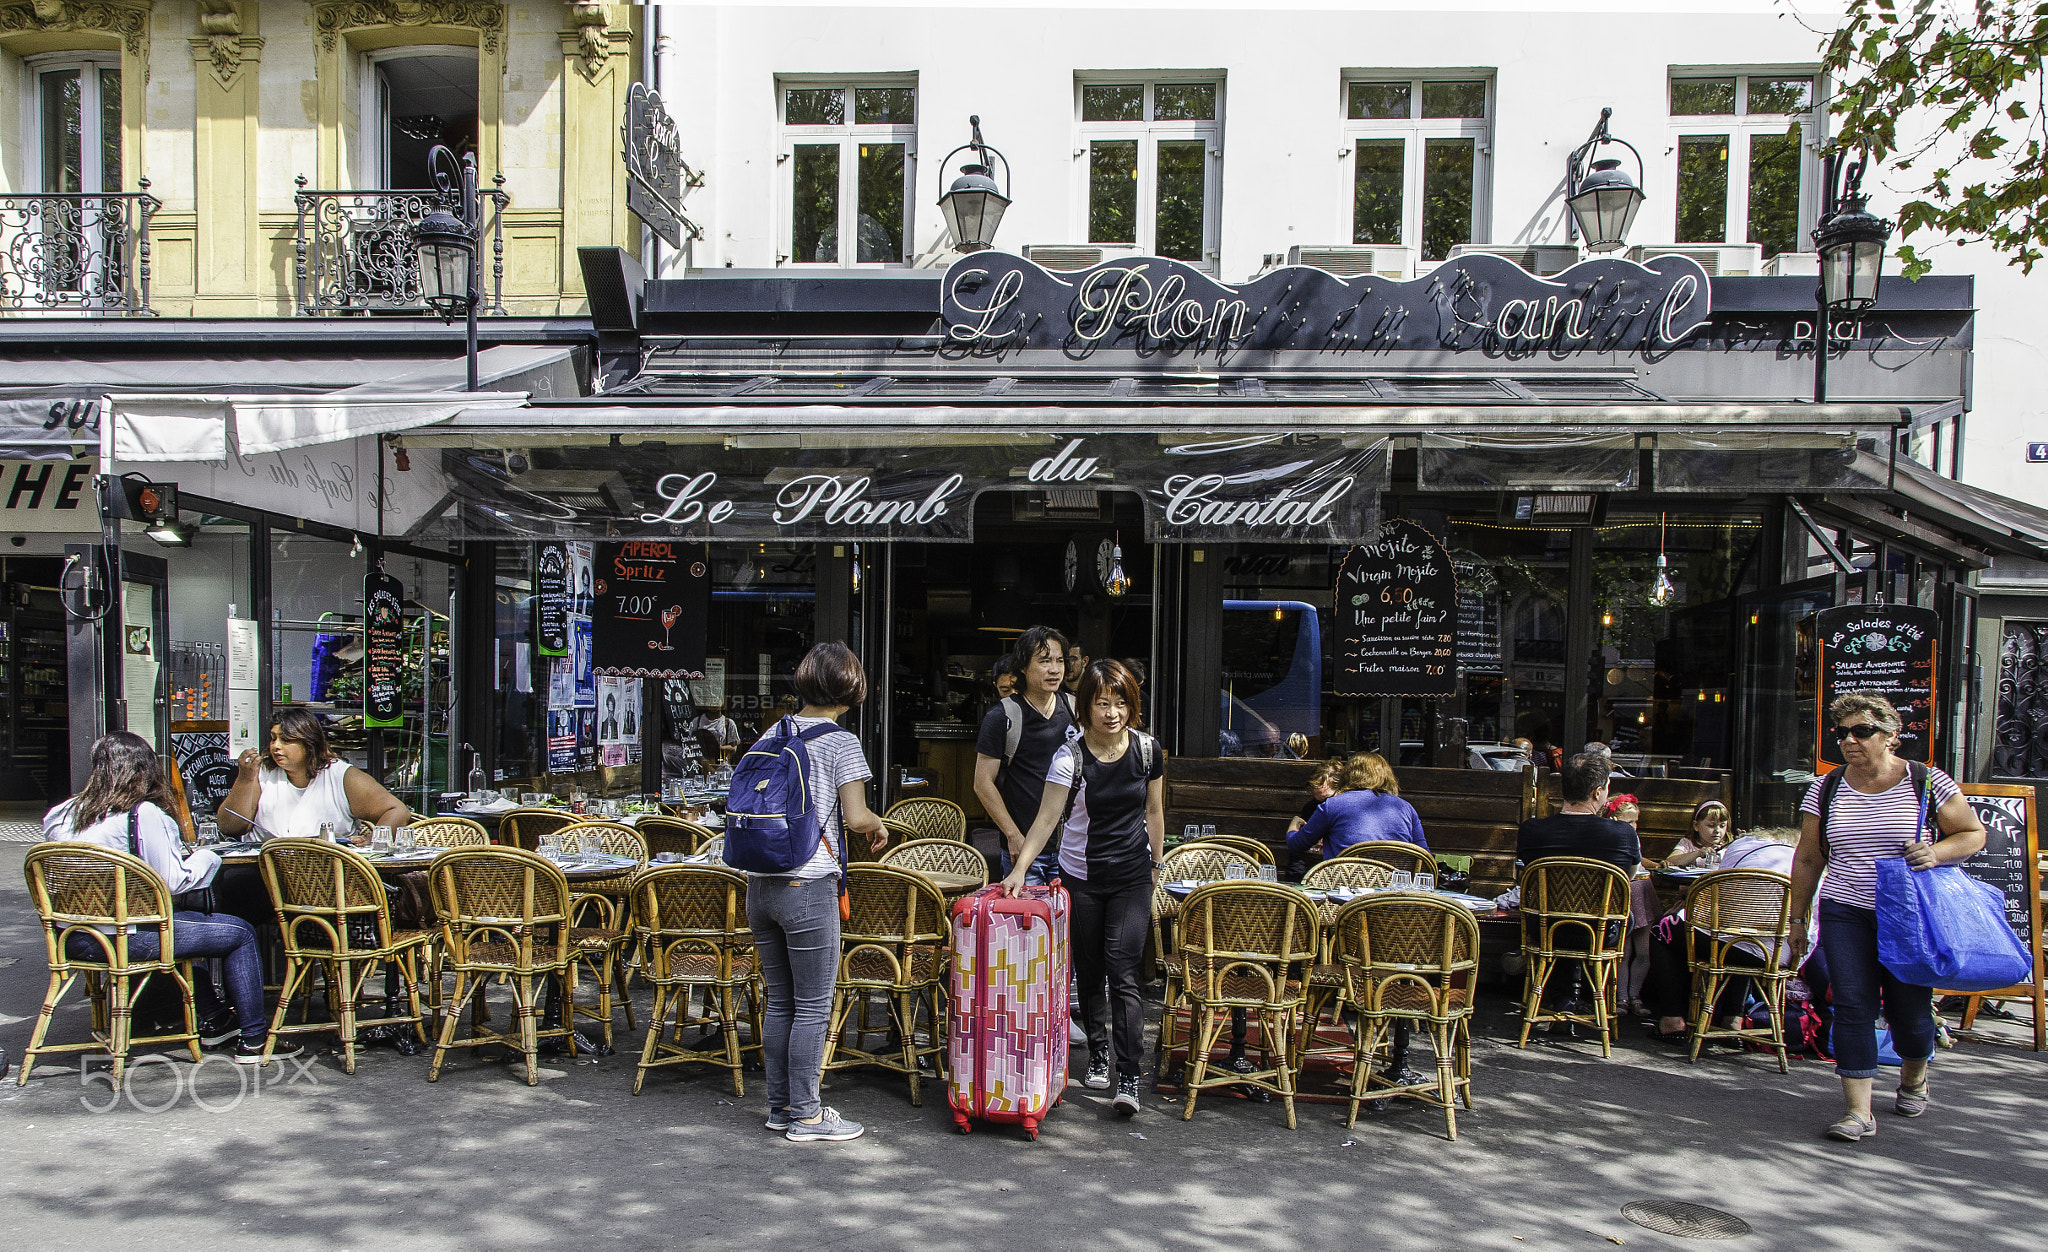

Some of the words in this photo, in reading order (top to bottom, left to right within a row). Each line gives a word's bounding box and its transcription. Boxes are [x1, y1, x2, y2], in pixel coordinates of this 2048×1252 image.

[0, 452, 92, 510] HÉ
[640, 472, 736, 526] Le
[772, 473, 965, 526] Plomb
[1027, 437, 1101, 483] du
[1162, 474, 1357, 526] Cantal
[620, 541, 677, 559] APEROL
[614, 557, 665, 581] Spritz
[1346, 564, 1392, 585] Virgin
[1395, 561, 1440, 584] Mojito
[1354, 609, 1376, 628] Une
[1381, 611, 1412, 632] petite
[1824, 631, 1846, 649] Les
[1846, 617, 1892, 633] Salades
[1388, 664, 1420, 673] maison
[1834, 661, 1864, 670] SALADE
